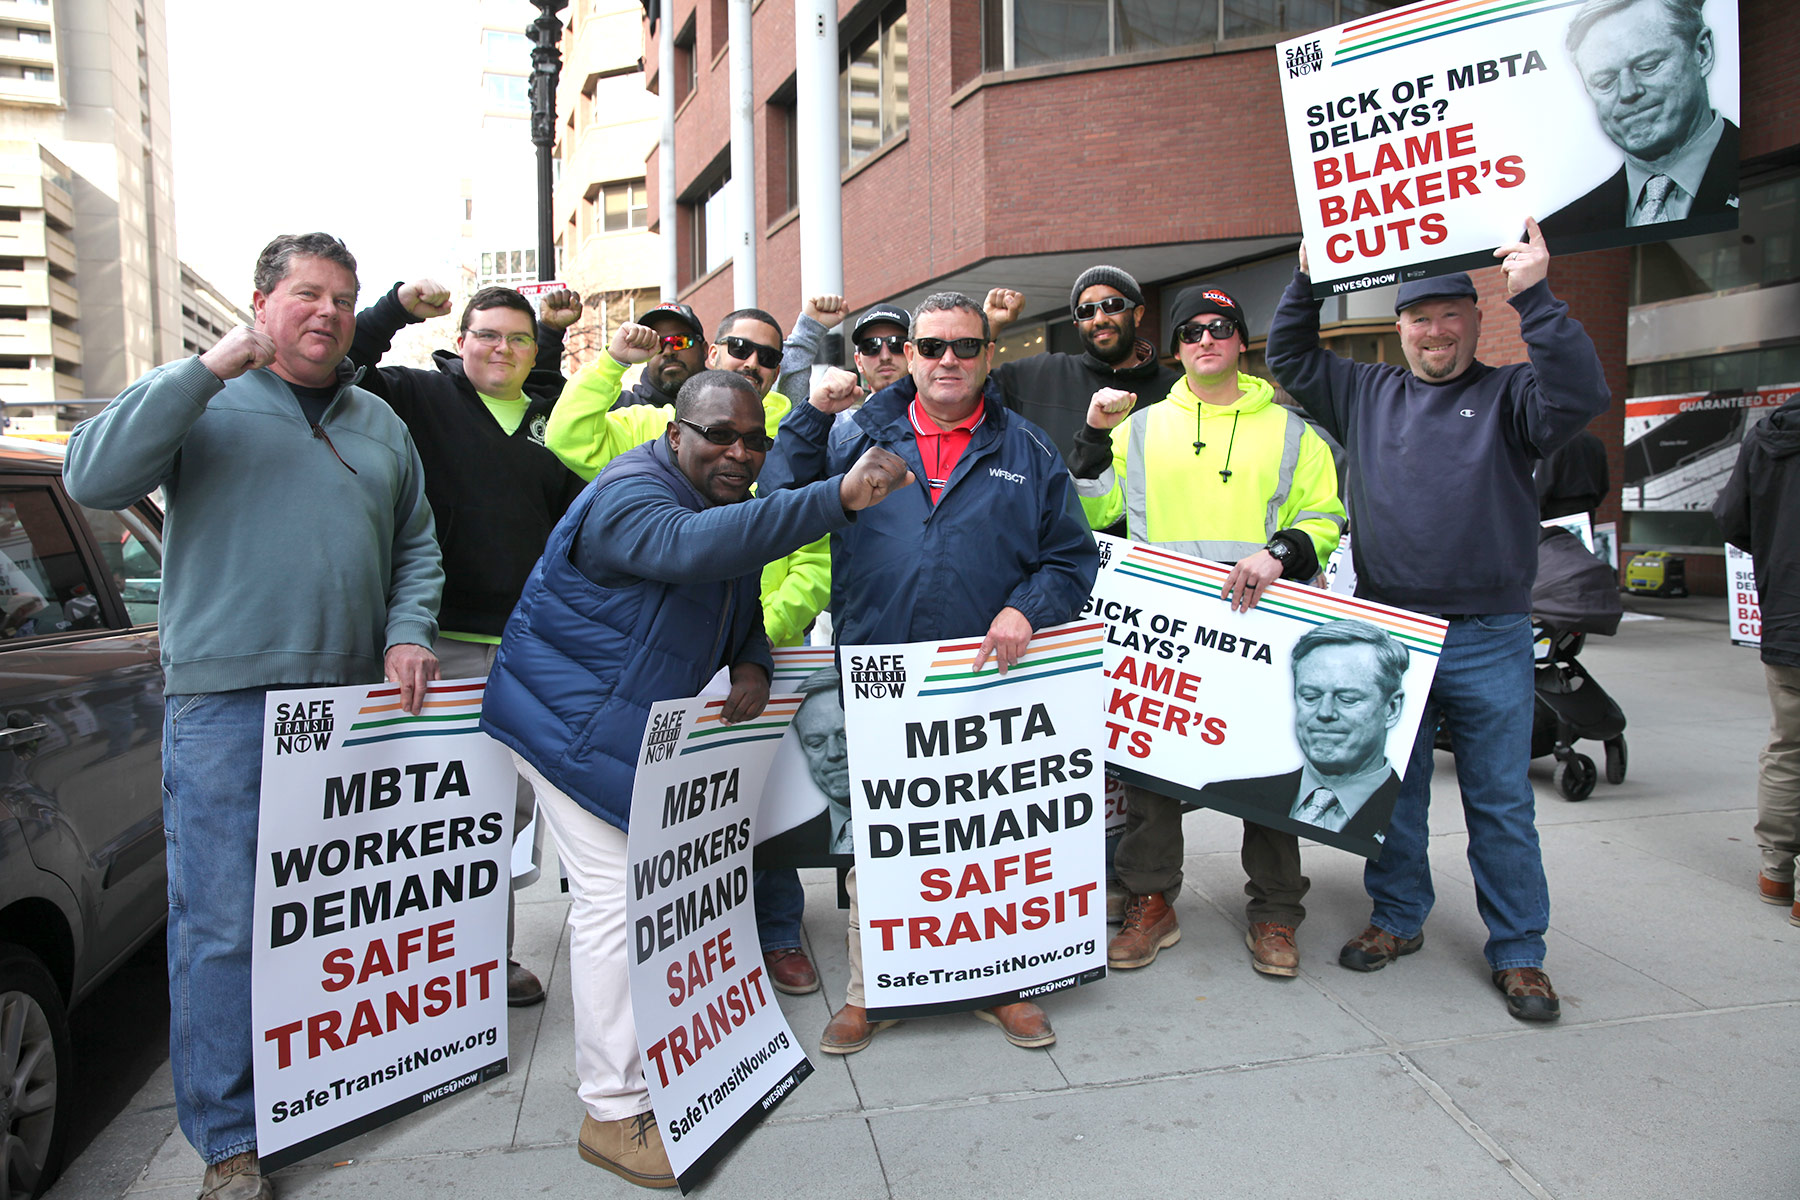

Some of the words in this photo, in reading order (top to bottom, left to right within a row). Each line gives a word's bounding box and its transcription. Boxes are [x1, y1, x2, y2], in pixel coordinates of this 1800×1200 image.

[1285, 39, 1321, 60] SAFE
[1290, 60, 1322, 79] NOW
[1306, 88, 1382, 127] SICK
[1391, 74, 1434, 104] OF
[1447, 49, 1548, 91] MBTA
[1309, 99, 1449, 153] DELAYS?
[1313, 122, 1477, 190] BLAME
[1319, 154, 1526, 228] BAKER'S
[1326, 212, 1448, 264] CUTS
[518, 285, 538, 295] TOW
[1679, 395, 1763, 412] GUARANTEED
[1735, 571, 1755, 580] SIC
[851, 655, 904, 671] SAFE
[1104, 623, 1190, 664] LAYS?
[1150, 614, 1188, 638] OF
[1193, 625, 1273, 665] MBTA
[851, 671, 906, 683] TRANSIT
[855, 683, 905, 699] NOW
[1104, 655, 1202, 703] AME
[274, 718, 334, 736] TRANSIT
[276, 699, 334, 721] SAFE
[652, 709, 686, 731] SAFE
[905, 702, 1057, 759] MBTA
[1104, 688, 1227, 746] KER'S
[277, 732, 331, 755] NOW
[645, 741, 677, 765] NOW
[1105, 720, 1153, 759] TS
[322, 759, 471, 820] MBTA
[661, 767, 740, 830] MBTA
[862, 748, 1094, 810] WORKERS
[270, 811, 503, 888] WORKERS
[868, 792, 1094, 859] DEMAND
[633, 817, 751, 901] WORKERS
[919, 847, 1053, 902] SAFE
[270, 859, 499, 949] DEMAND
[636, 865, 748, 966] DEMAND
[869, 881, 1098, 952] TRANSIT
[320, 919, 456, 993] SAFE
[665, 927, 736, 1008] SAFE
[876, 939, 1096, 989] SafeTransitNow.org
[264, 959, 499, 1071] TRANSIT
[646, 966, 768, 1090] TRANSIT
[271, 1026, 497, 1124] SafeTransitNow.org
[669, 1030, 790, 1144] SafeTransitNow.org
